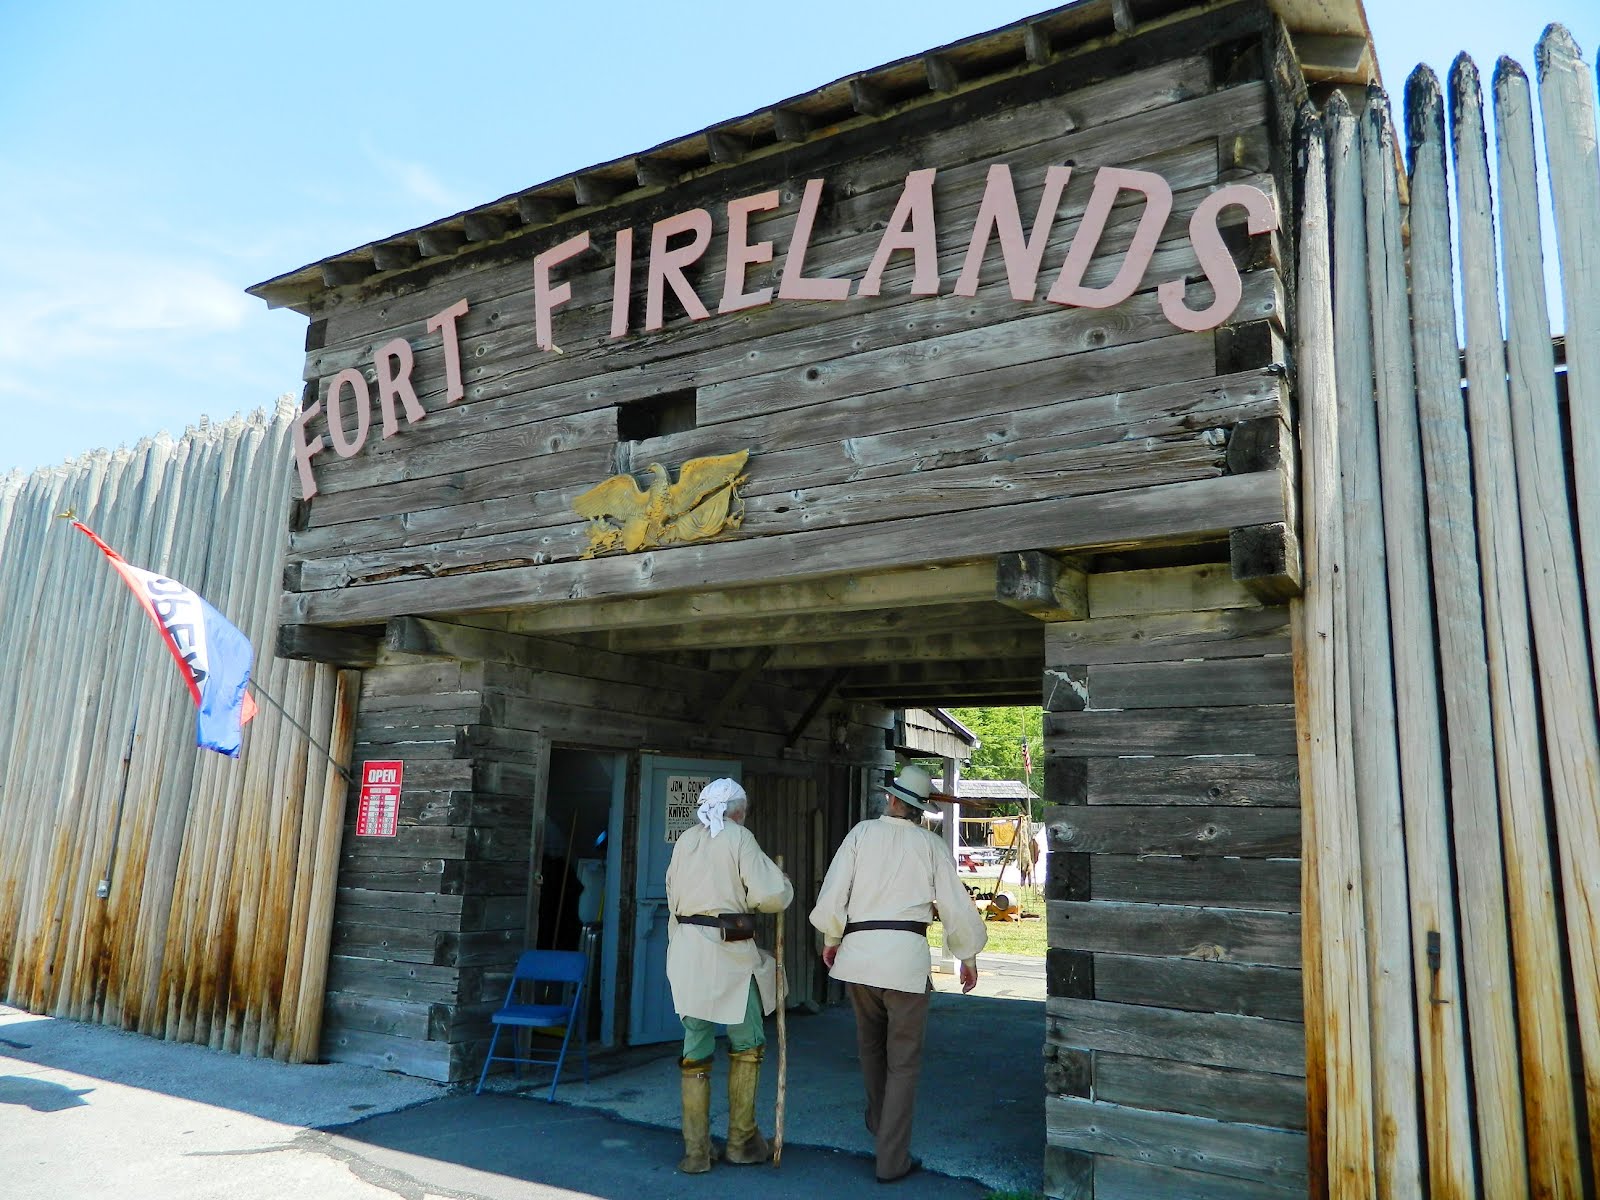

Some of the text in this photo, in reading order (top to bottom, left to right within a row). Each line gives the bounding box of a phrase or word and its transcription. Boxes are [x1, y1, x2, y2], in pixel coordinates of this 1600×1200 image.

[290, 163, 1278, 501] FORT FIRELANDS
[368, 770, 396, 782] OPEN
[681, 793, 698, 804] PLUS
